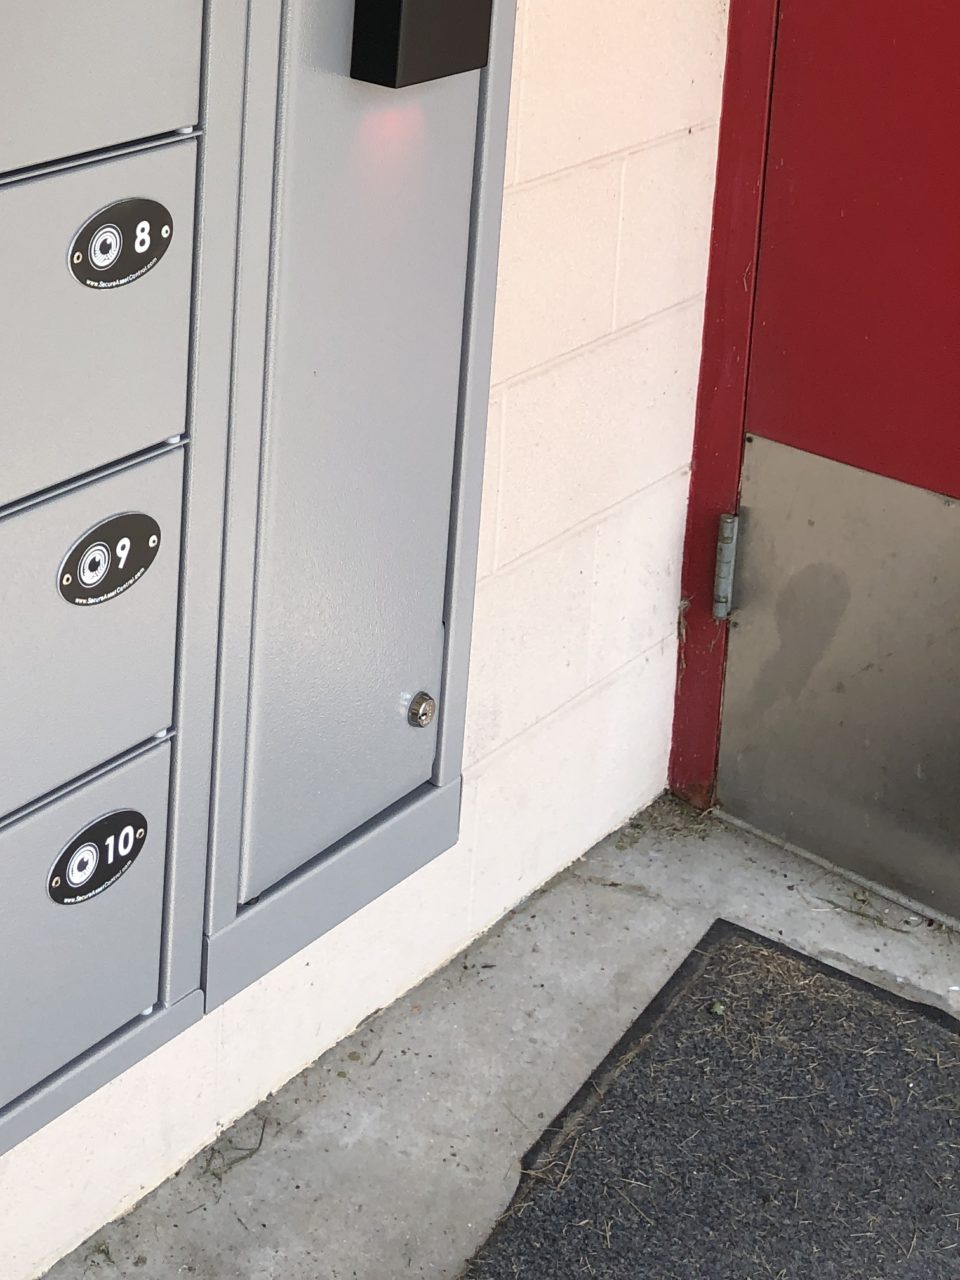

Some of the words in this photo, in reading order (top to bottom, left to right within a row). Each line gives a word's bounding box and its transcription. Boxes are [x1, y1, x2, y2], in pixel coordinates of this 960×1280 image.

[134, 220, 151, 254] 8
[115, 536, 131, 569] 9
[104, 825, 135, 865] 10
